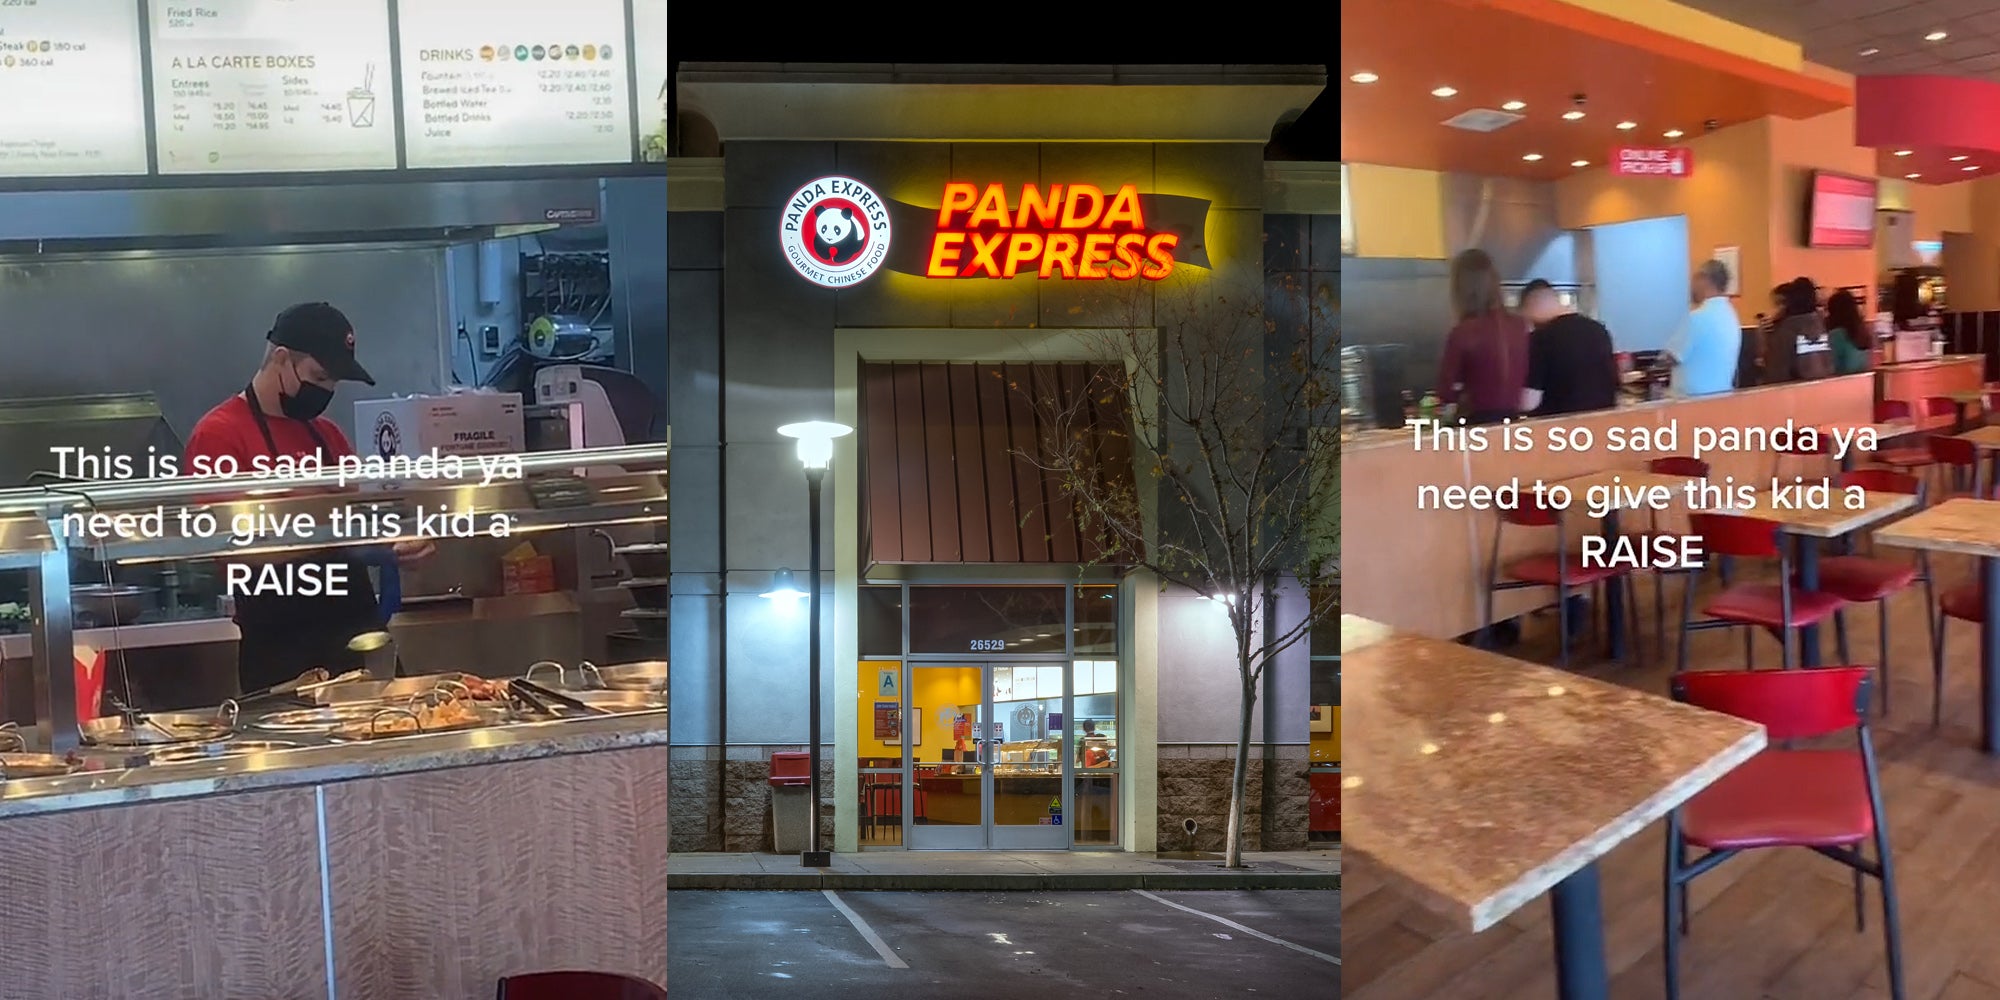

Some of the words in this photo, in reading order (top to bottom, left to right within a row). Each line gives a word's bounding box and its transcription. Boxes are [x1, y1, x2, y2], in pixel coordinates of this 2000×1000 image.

[167, 8, 192, 17] Fried
[196, 8, 218, 17] Rice
[420, 48, 474, 61] DRINKS
[172, 56, 182, 68] A
[187, 56, 207, 68] LA
[211, 55, 262, 68] CARTE
[266, 55, 315, 68] BOXES
[171, 79, 209, 88] Entrees
[282, 75, 308, 85] Sides
[423, 85, 457, 94] Brewed
[481, 84, 496, 93] Tea
[423, 100, 458, 109] Bottled
[425, 113, 459, 123] Bottled
[462, 113, 491, 122] Drinks
[425, 127, 451, 137] Juice
[785, 183, 826, 231] PANDA
[831, 180, 887, 231] EXPRESS
[936, 183, 1146, 229] PANDA
[926, 232, 1179, 280] EXPRESS
[788, 245, 825, 281] GOURMET
[827, 267, 867, 284] CHINESE
[867, 243, 885, 269] FOOD
[453, 430, 495, 441] FRAGILE
[970, 639, 1005, 650] 26529
[883, 675, 894, 688] A
